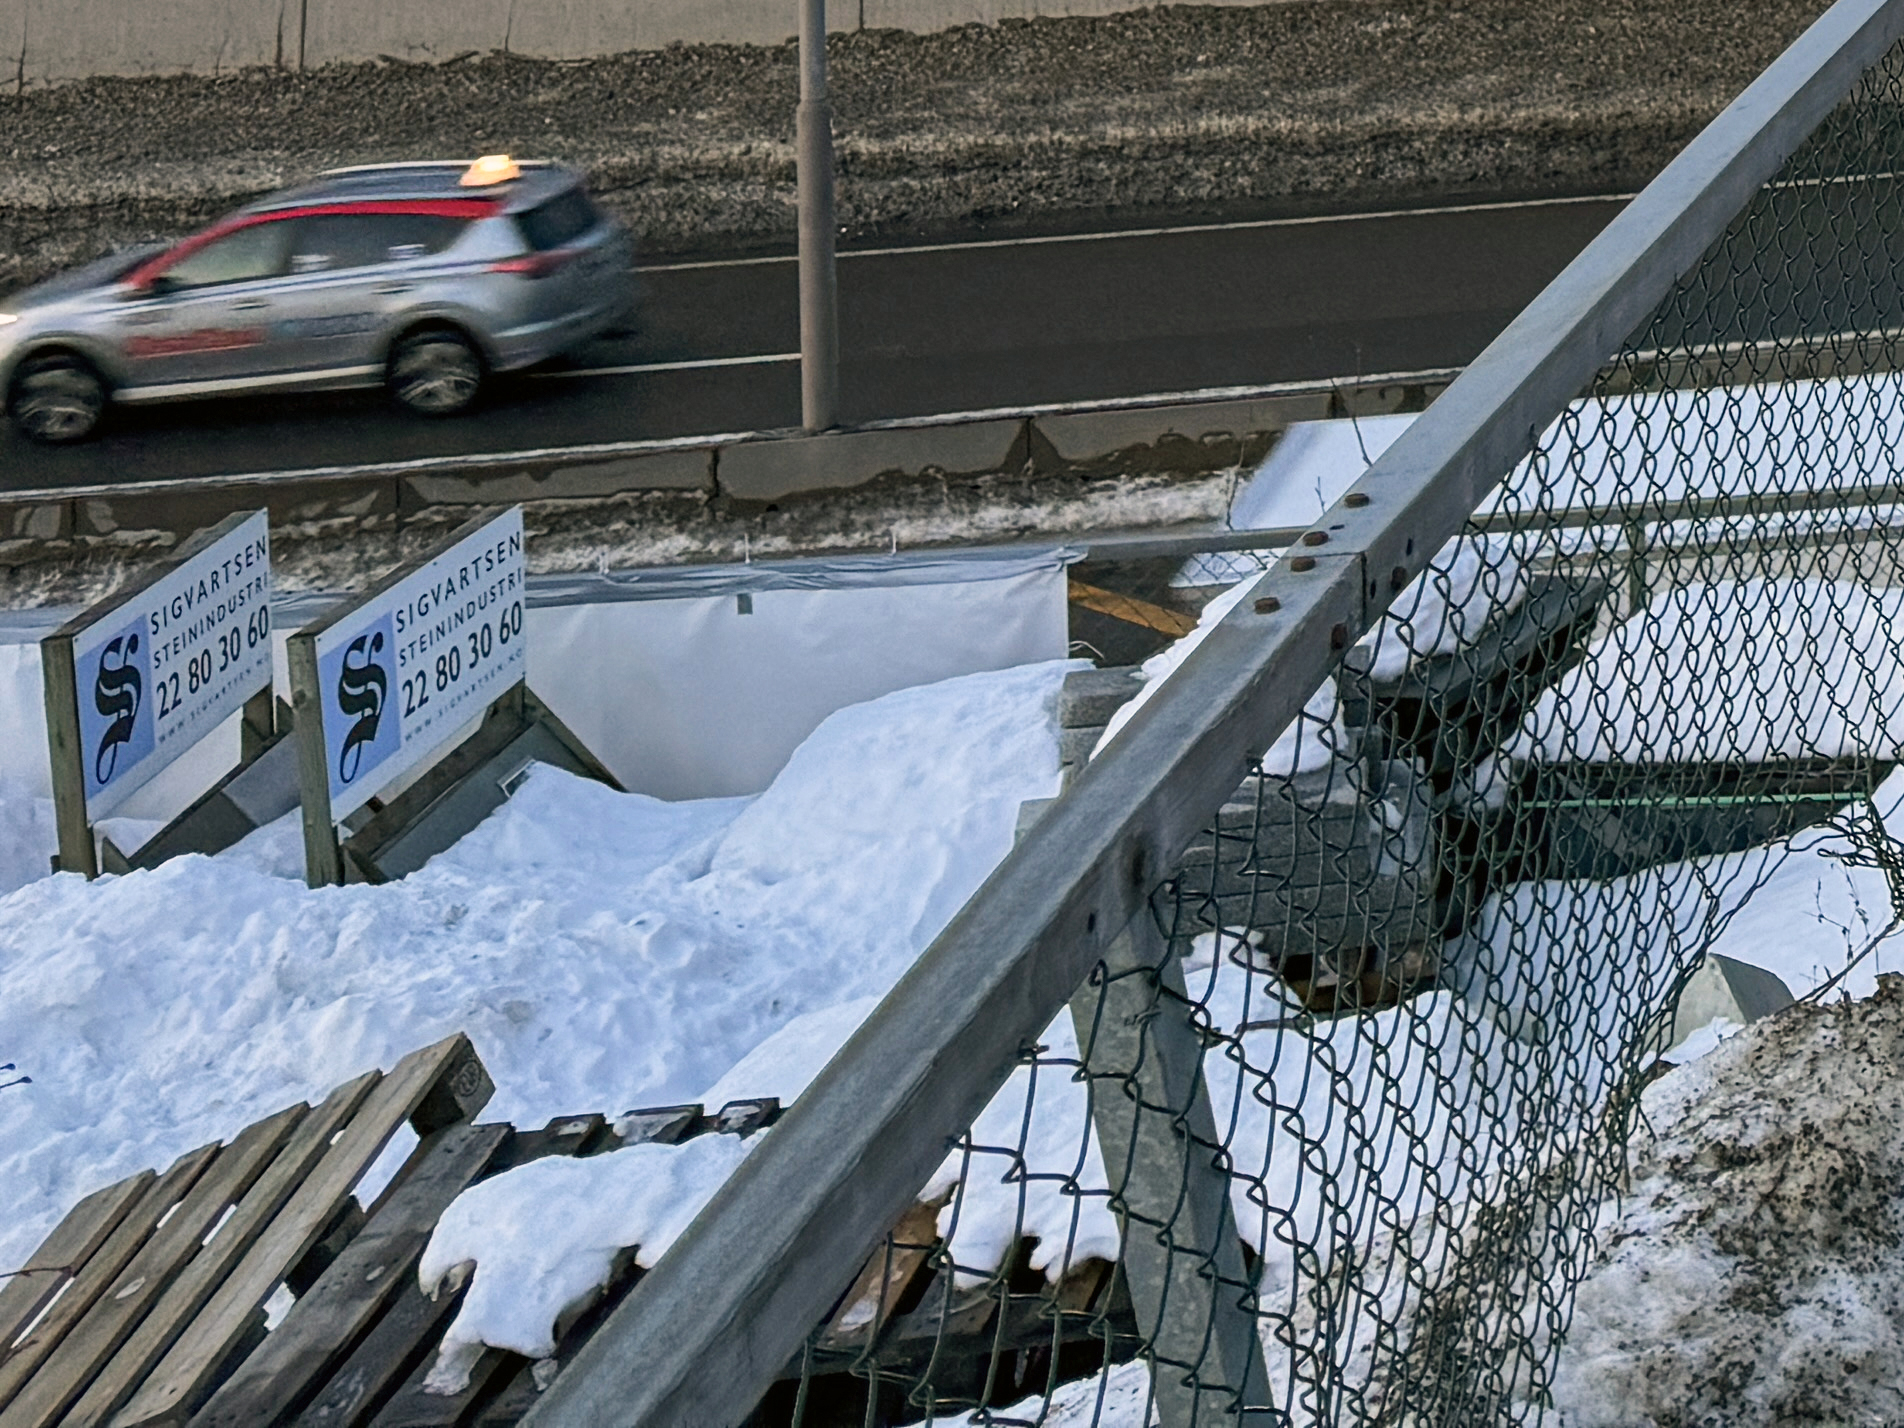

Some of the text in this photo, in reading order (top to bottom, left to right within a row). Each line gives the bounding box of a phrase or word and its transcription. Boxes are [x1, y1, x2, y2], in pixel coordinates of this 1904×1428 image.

[150, 535, 267, 636] SIGVARTSEN
[153, 571, 268, 670] STEININDUSTRI
[396, 531, 521, 634] SIGVARTSEN
[400, 567, 522, 668] STEININDUSTRI
[156, 604, 269, 721] 22 80 30 60
[402, 600, 522, 720] 22 80 30 60
